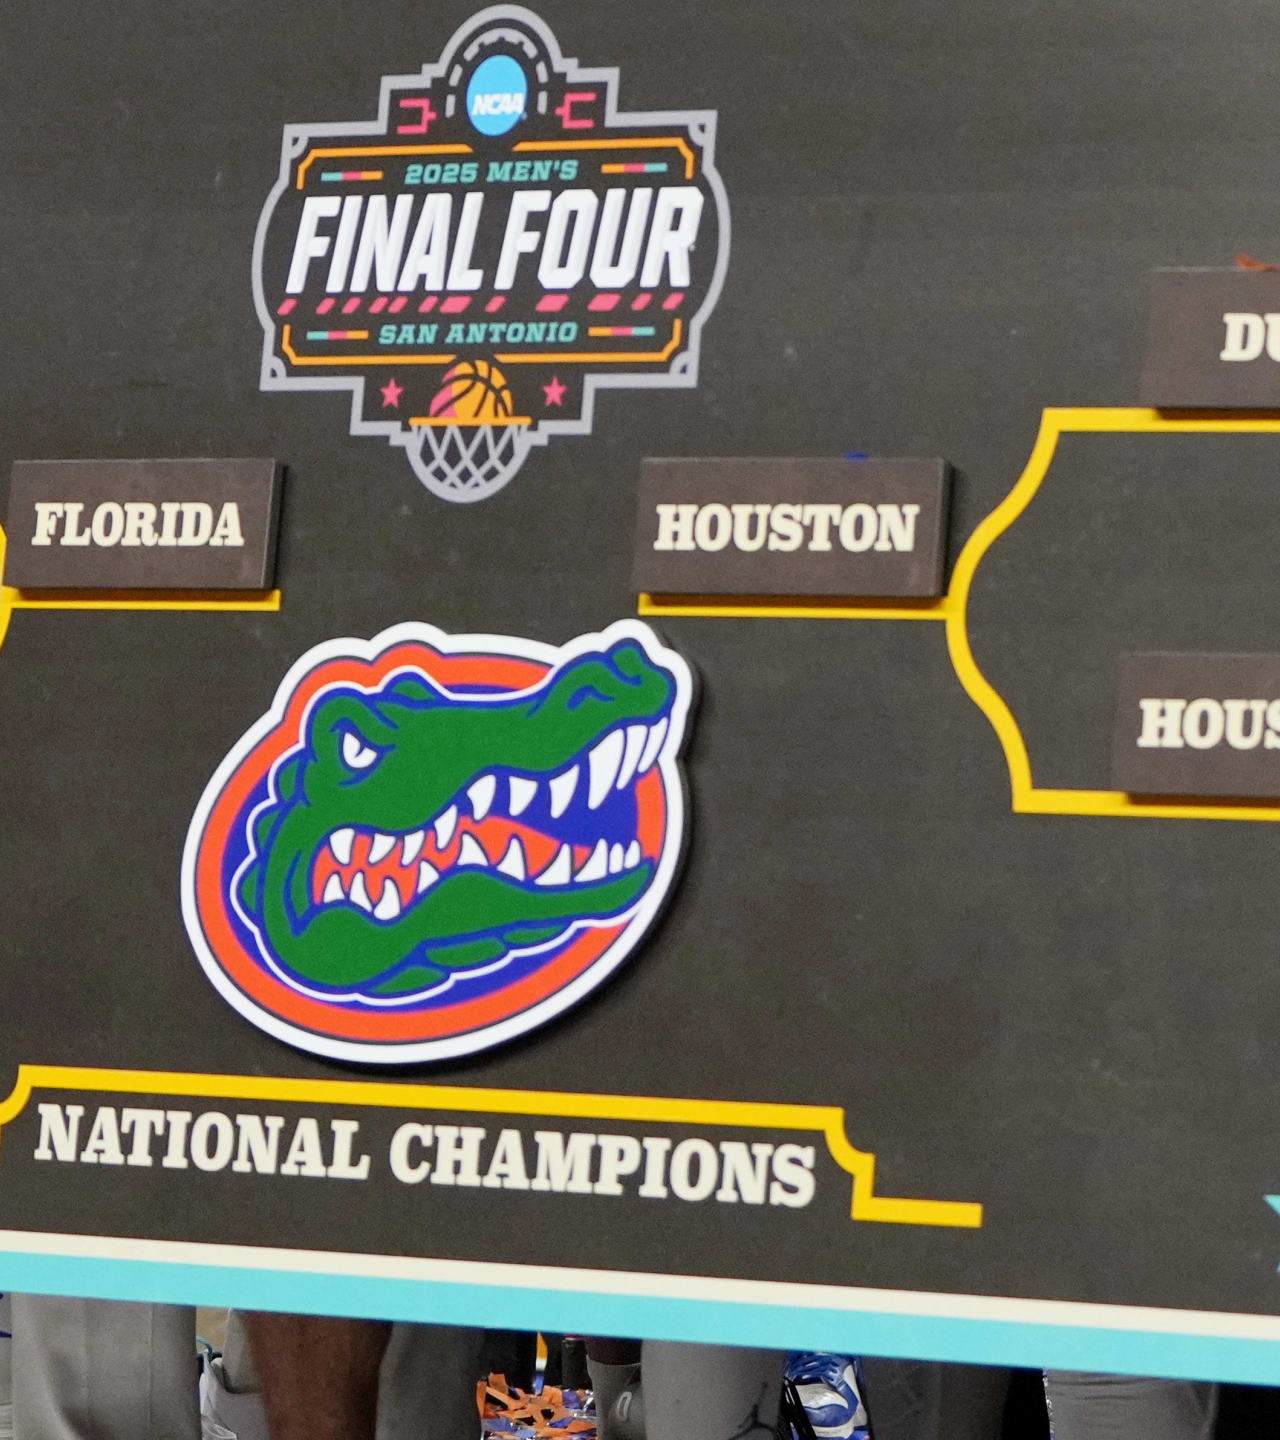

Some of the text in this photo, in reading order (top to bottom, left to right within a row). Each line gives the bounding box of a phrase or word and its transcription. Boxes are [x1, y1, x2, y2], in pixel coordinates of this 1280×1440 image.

[471, 93, 524, 116] NCAA
[404, 160, 579, 185] 2025 MEN'S
[285, 186, 705, 294] FINAL FOUR
[378, 321, 578, 345] SAN ANTONIO
[31, 502, 244, 548] FLORIDA
[653, 503, 921, 553] HOUSTON
[33, 1102, 817, 1209] NATIONAL CHAMPIONS
